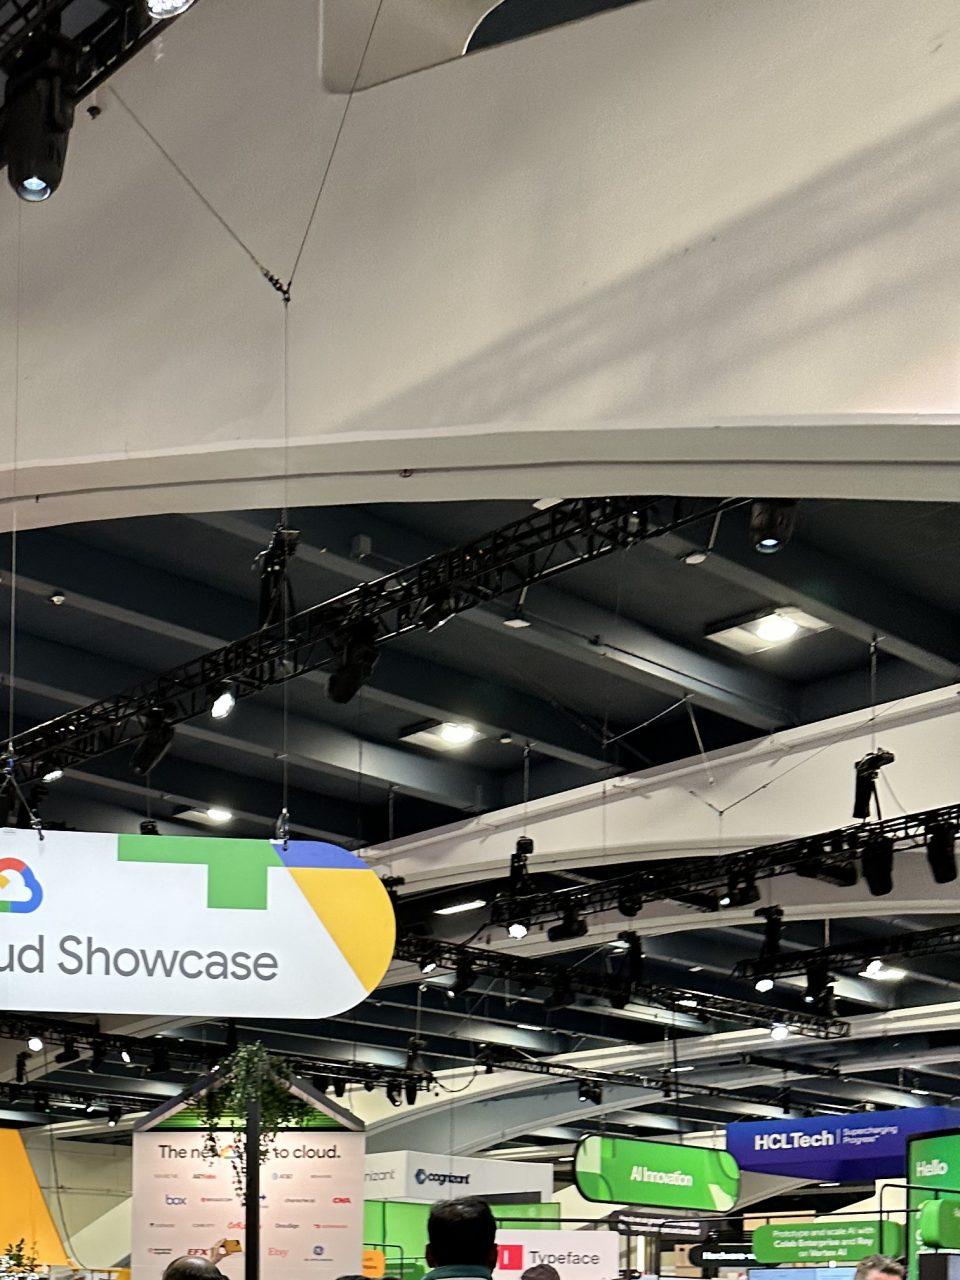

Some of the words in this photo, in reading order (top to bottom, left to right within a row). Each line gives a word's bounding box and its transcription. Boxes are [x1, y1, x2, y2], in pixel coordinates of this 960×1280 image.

[57, 934, 279, 981] Showcase
[842, 1126, 898, 1137] Supercharging
[754, 1130, 835, 1151] HCLTech
[158, 1144, 187, 1159] The
[191, 1147, 218, 1159] ne
[273, 1147, 289, 1159] to
[293, 1144, 342, 1159] cloud.
[916, 1158, 949, 1177] Hello
[364, 1170, 396, 1182] nizant
[426, 1171, 470, 1185] cognizant
[630, 1166, 642, 1182] AI
[643, 1167, 693, 1187] Innovation
[165, 1194, 187, 1206] box
[529, 1250, 600, 1265] Typeface
